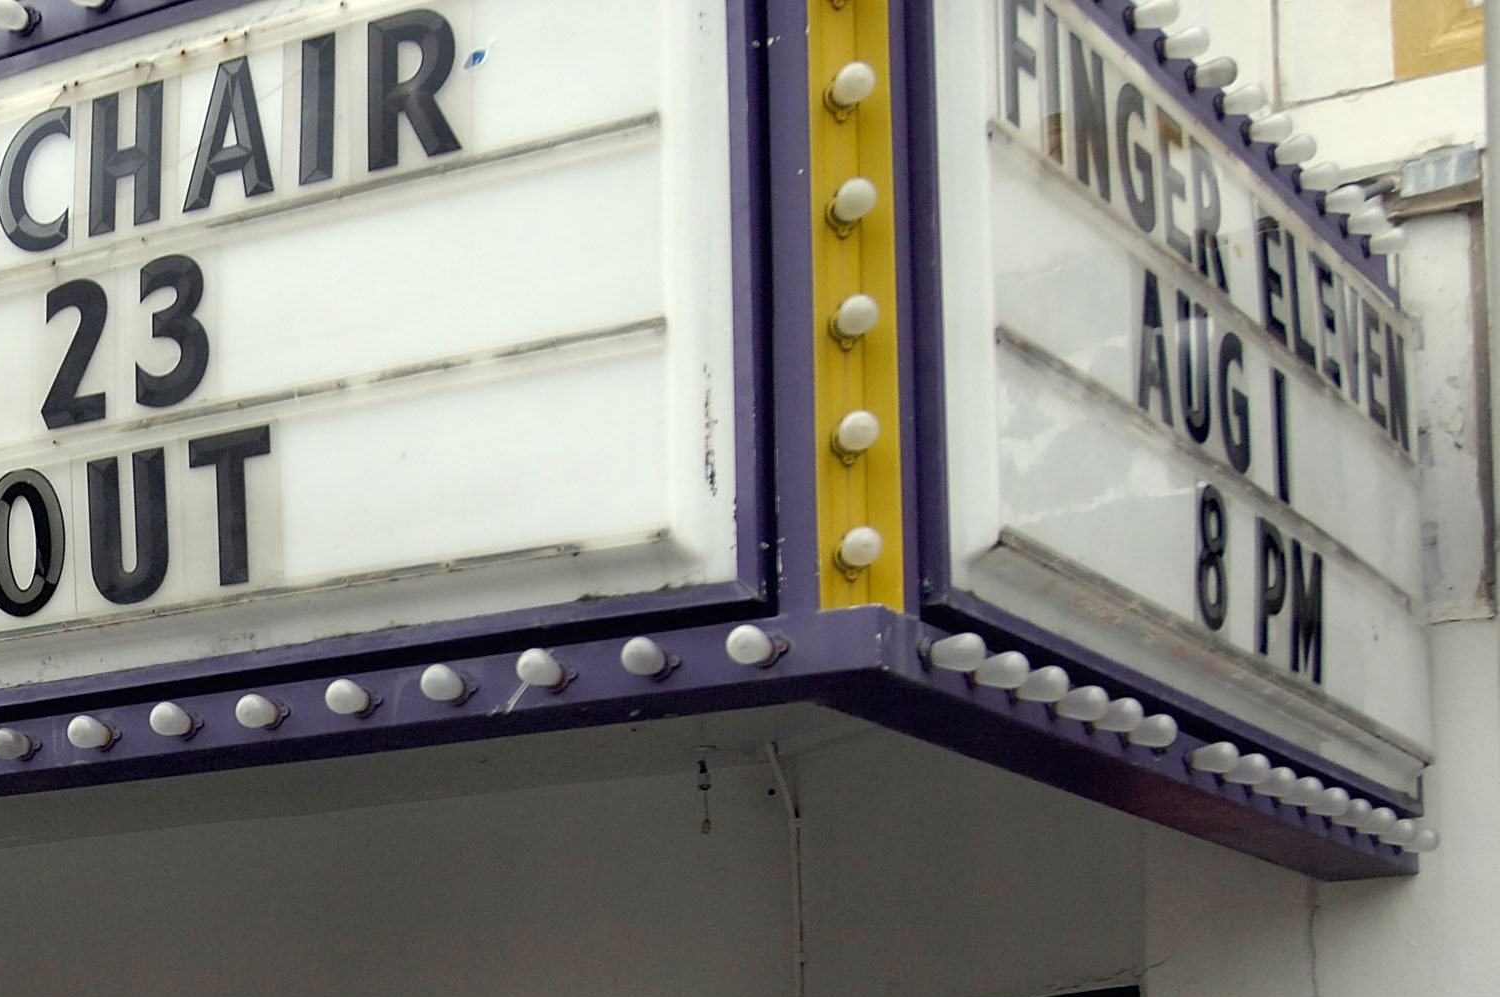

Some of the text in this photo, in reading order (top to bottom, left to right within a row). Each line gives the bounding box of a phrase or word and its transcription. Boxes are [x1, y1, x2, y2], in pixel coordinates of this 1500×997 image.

[1003, 0, 1410, 454] FINGER ELEVEN
[40, 254, 212, 430] 23
[1137, 268, 1252, 475] AUG
[1195, 482, 1325, 686] 8 PM
